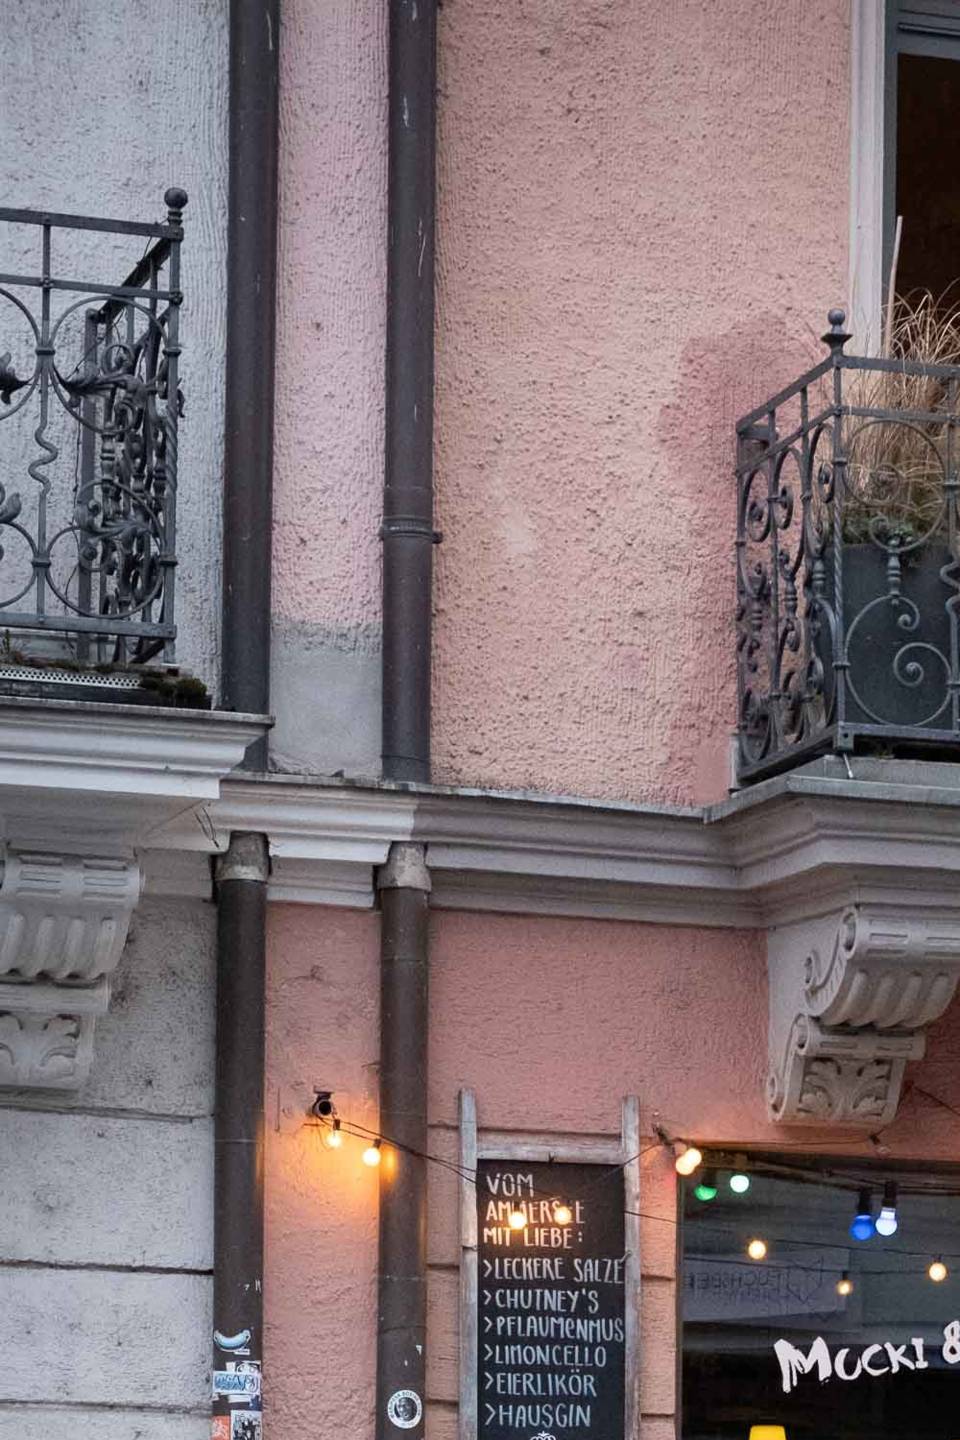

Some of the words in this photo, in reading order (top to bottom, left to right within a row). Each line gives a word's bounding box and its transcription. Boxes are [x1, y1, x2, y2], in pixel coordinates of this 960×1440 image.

[487, 1173, 534, 1197] VOM
[486, 1199, 585, 1224] AMERSE
[484, 1227, 511, 1247] MIT
[495, 1258, 565, 1281] LECKERE
[574, 1259, 624, 1284] SALZE
[495, 1289, 599, 1313] CHUTNEY'S
[495, 1345, 607, 1368] LIMONCELLO
[497, 1369, 597, 1397] EIERLIKÖR
[499, 1405, 591, 1428] HAUSGIN
